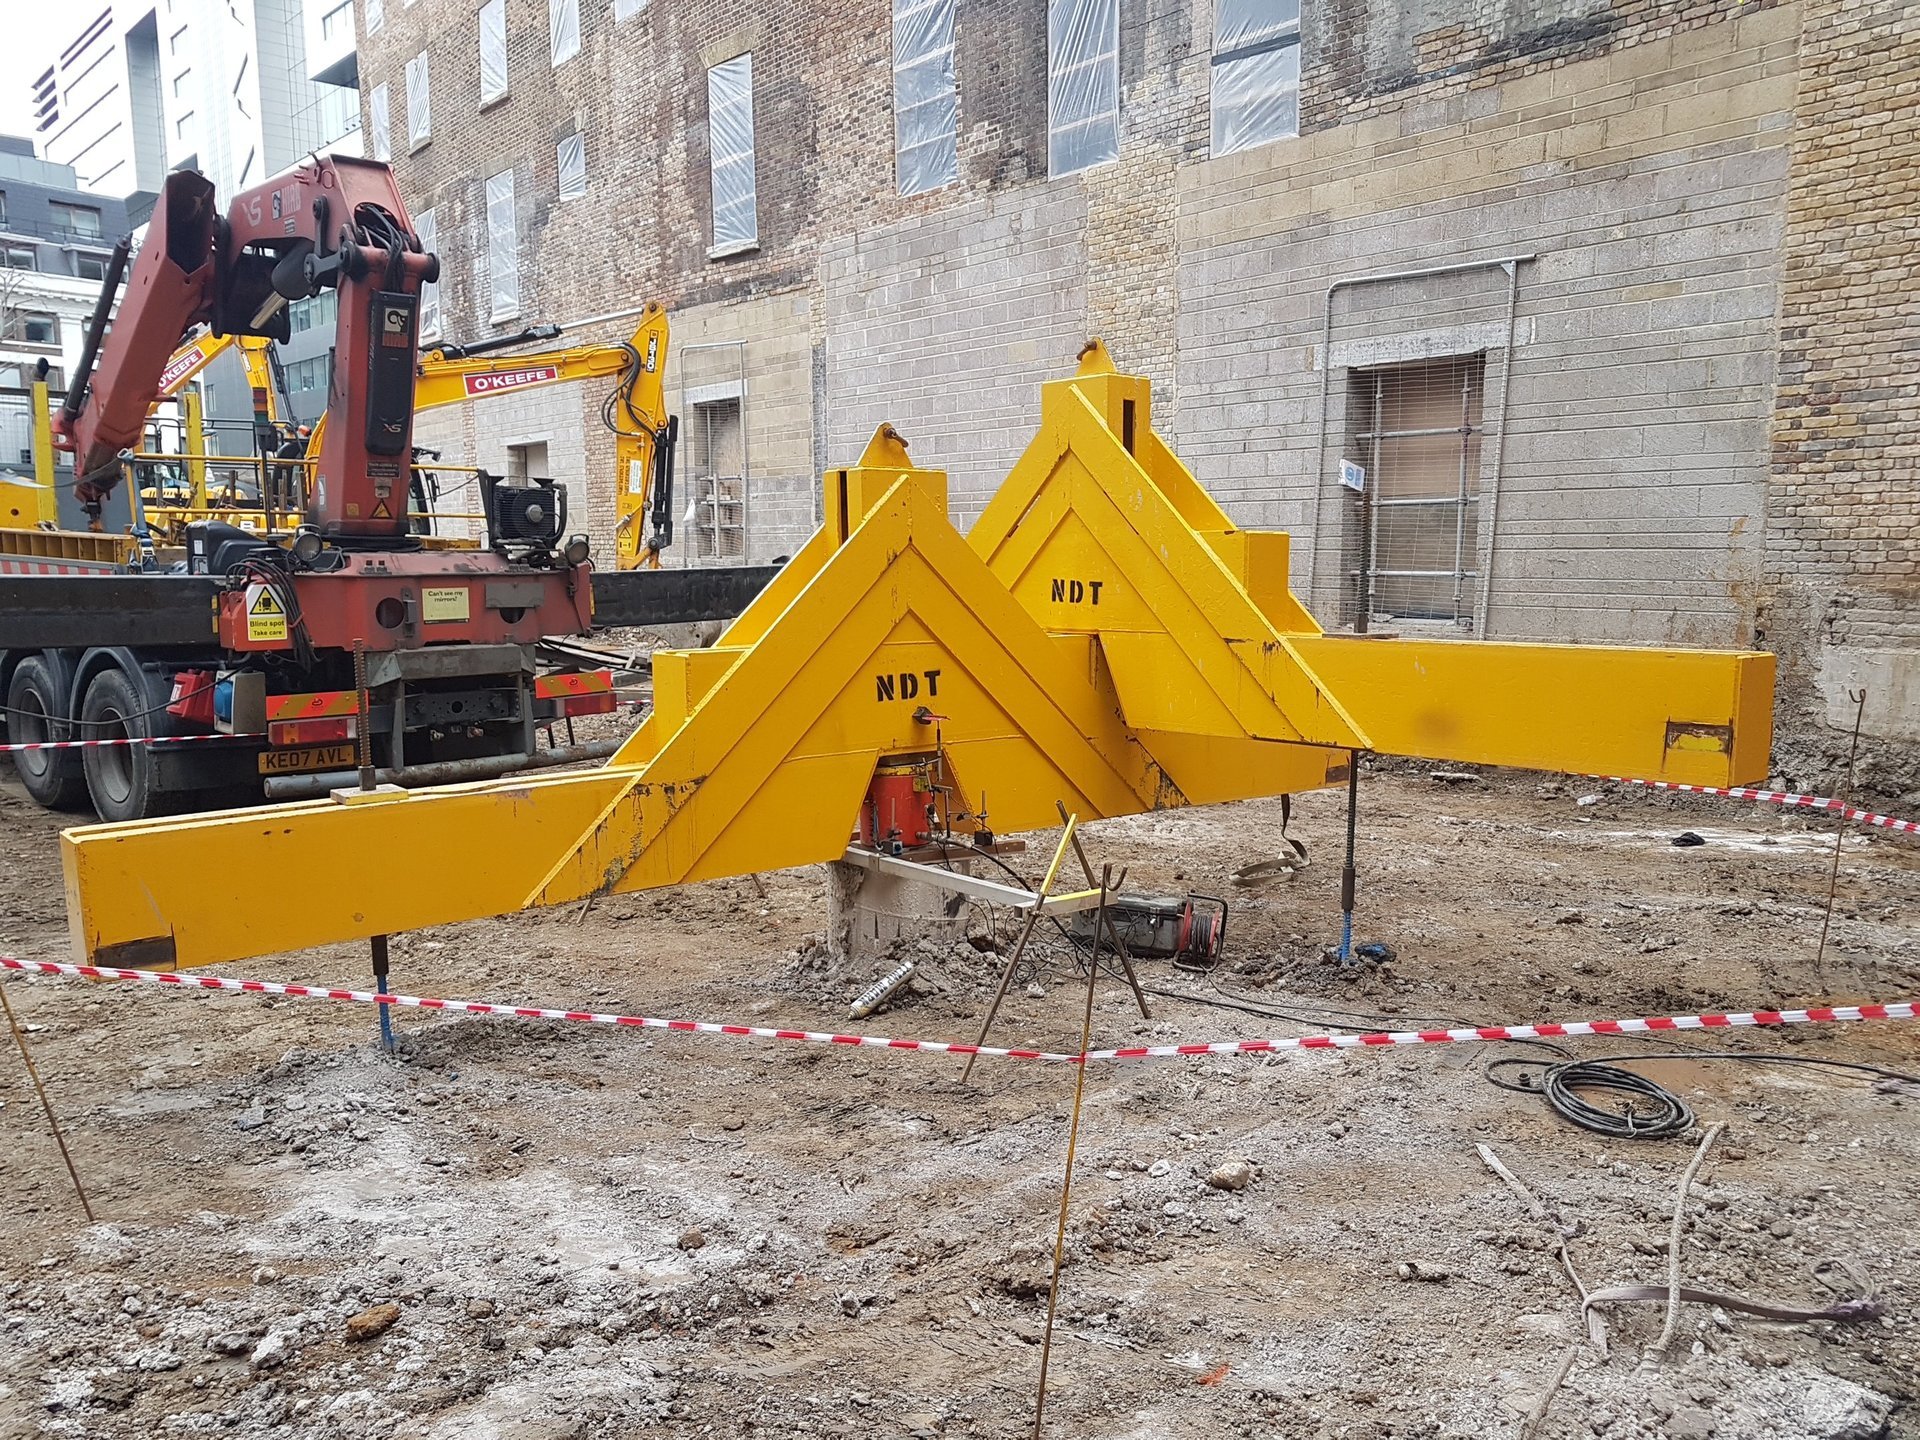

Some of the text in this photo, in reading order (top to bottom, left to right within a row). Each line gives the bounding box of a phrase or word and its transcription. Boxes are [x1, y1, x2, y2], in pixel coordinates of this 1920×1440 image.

[474, 370, 548, 390] O'KEEFE
[1051, 578, 1103, 605] NDT
[876, 670, 941, 702] NDT
[266, 748, 347, 769] KE07 AVL
